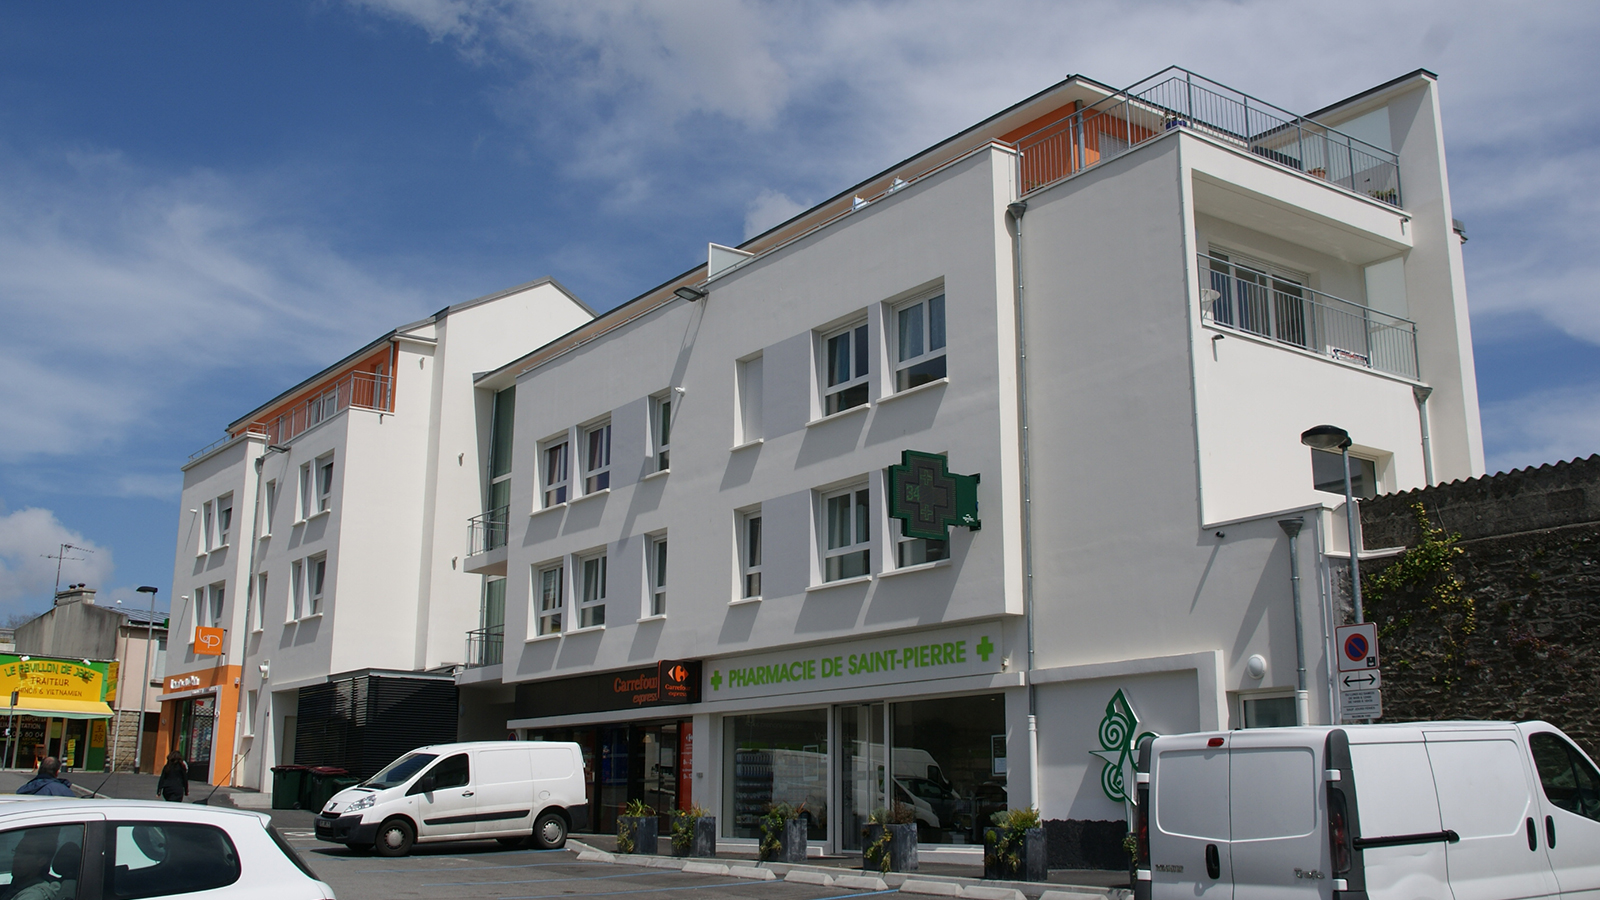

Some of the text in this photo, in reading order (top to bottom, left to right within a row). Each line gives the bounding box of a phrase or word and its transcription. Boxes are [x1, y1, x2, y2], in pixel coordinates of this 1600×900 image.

[4, 665, 17, 677] LE
[18, 663, 59, 675] PAVILLON
[60, 664, 73, 675] DE
[728, 640, 967, 688] PHARMACIE DE SAINT-PIERRE
[30, 676, 70, 687] TRAITEUR
[664, 683, 691, 691] Carrefour
[46, 688, 83, 697] VIETNAMIEN
[632, 692, 658, 705] express
